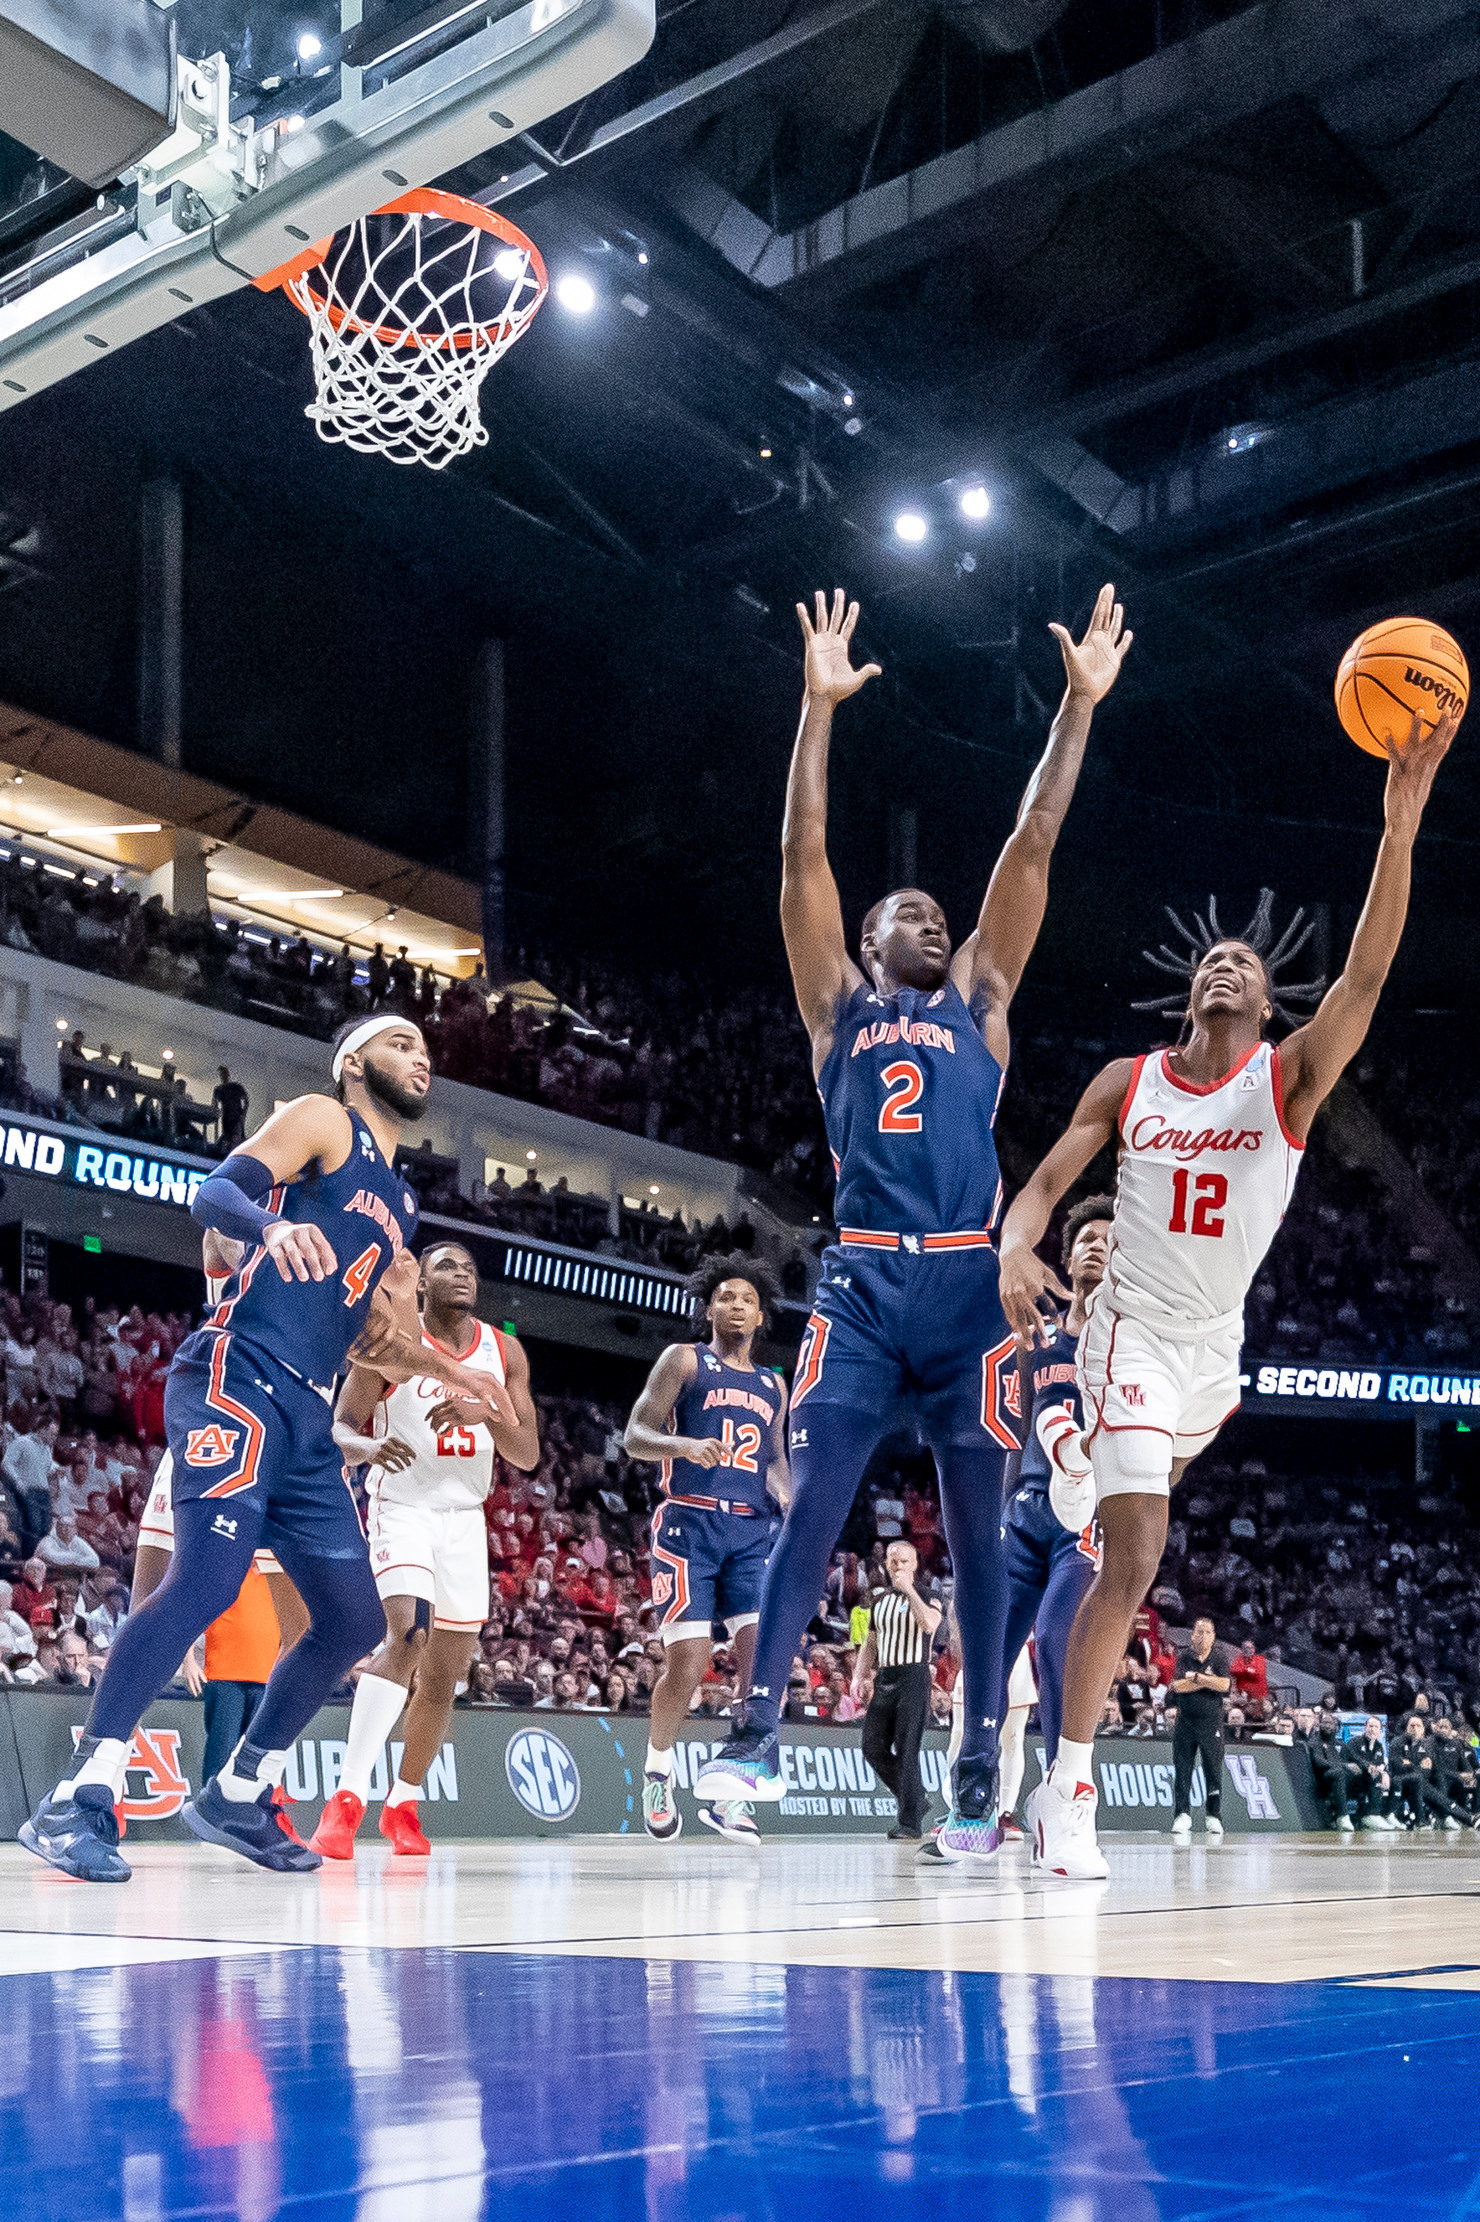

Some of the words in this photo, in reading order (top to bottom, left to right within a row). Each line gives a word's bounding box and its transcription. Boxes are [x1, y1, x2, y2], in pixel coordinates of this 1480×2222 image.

[1404, 665, 1465, 721] Wilson
[851, 1015, 956, 1058] AUBURN
[878, 1060, 924, 1133] 2
[0, 1124, 66, 1175] ND
[1131, 1114, 1264, 1162] Cougars
[1168, 1167, 1229, 1238] 12
[342, 1242, 382, 1308] 4
[702, 1387, 774, 1427] AUBURN
[1256, 1366, 1382, 1400] SECOND
[437, 1425, 477, 1457] 25
[720, 1417, 761, 1474] 12
[509, 1734, 575, 1814] SEC
[779, 1744, 877, 1792] ECOND
[779, 1797, 829, 1816] HOSTED
[831, 1798, 847, 1817] BY
[848, 1798, 873, 1817] THE
[874, 1798, 898, 1817] SEC
